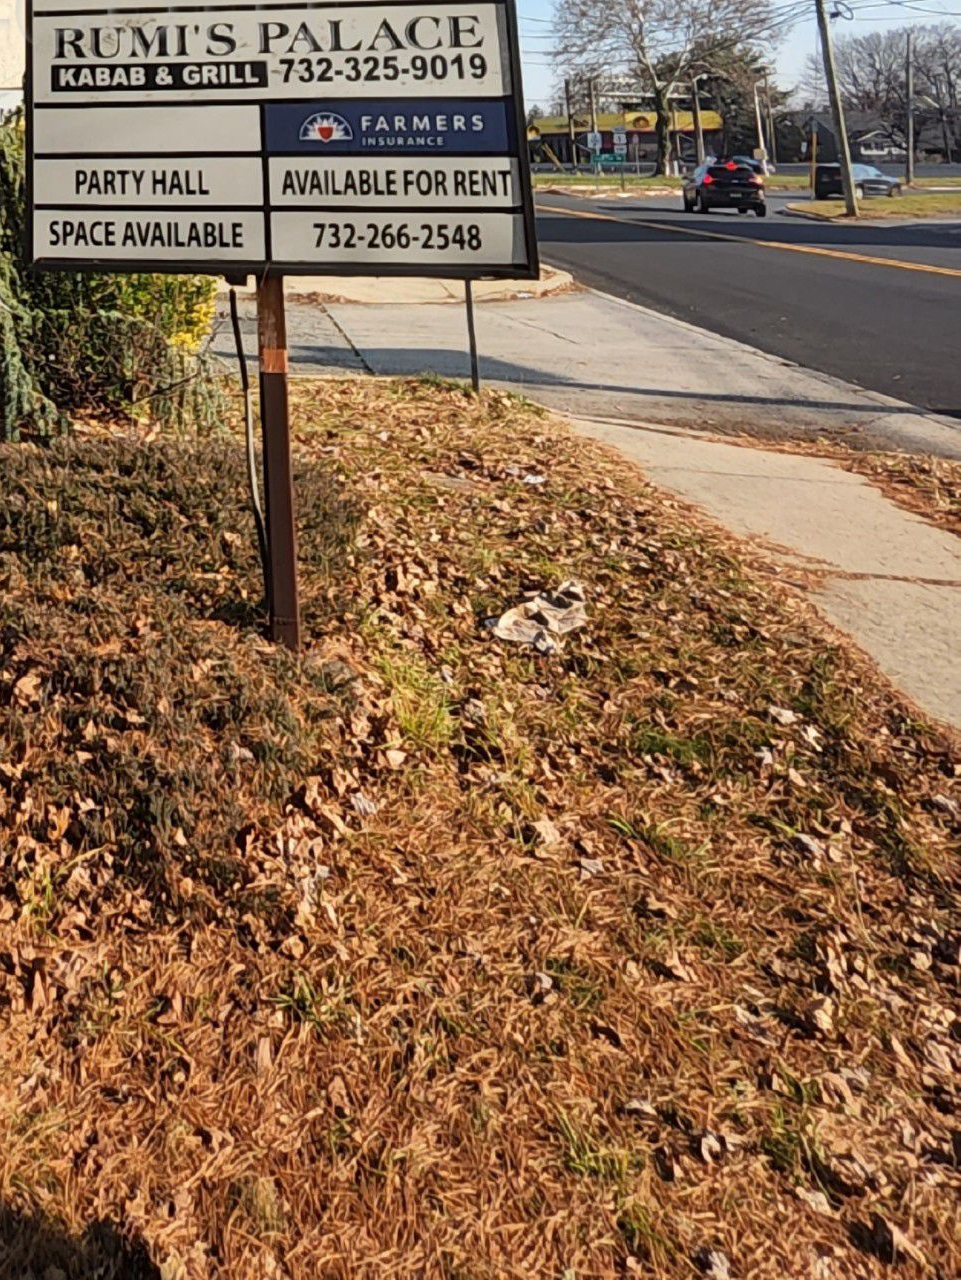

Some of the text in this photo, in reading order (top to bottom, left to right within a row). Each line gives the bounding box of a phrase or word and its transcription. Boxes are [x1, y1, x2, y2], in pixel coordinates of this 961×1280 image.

[53, 15, 484, 59] RUMI'S PALACE
[58, 63, 260, 88] KABAB & GRILL
[279, 53, 487, 85] 732-325-9019
[361, 114, 484, 132] FARMERS
[361, 136, 444, 147] INSURANCE
[74, 169, 210, 196] PARTY HALL
[281, 169, 512, 197] AVAILABLE FOR RENT
[49, 221, 244, 248] SPACE AVAILABLE
[312, 222, 482, 252] 732-266-2548
